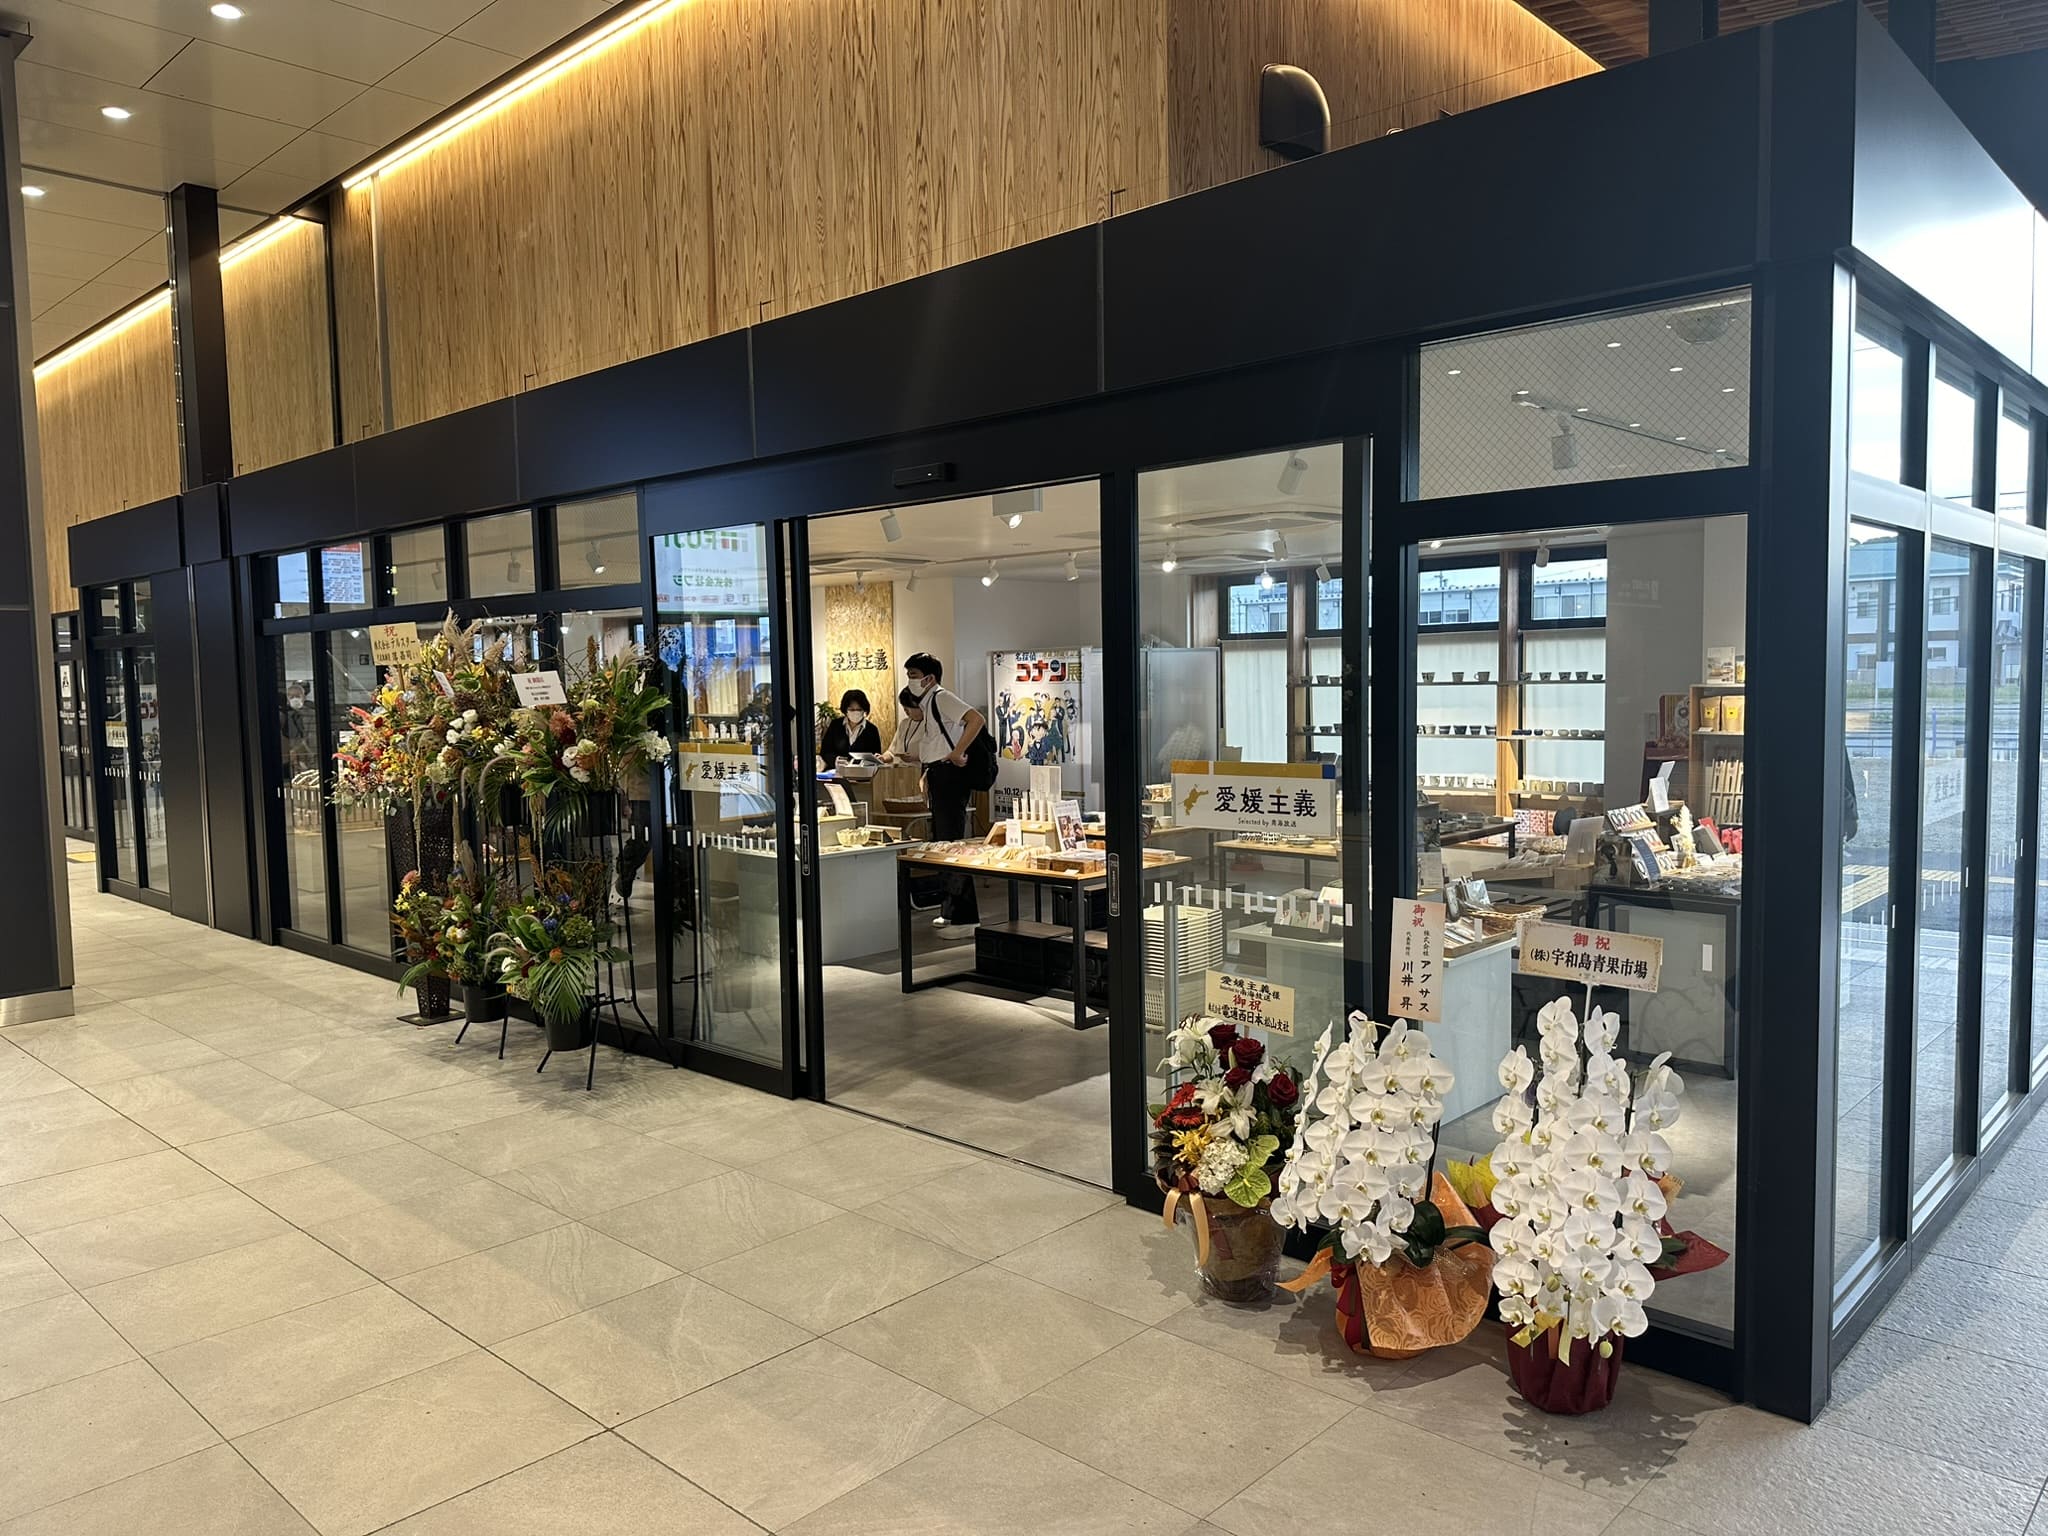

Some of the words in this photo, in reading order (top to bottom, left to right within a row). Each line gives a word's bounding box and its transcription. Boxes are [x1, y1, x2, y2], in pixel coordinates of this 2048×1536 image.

[1015, 660, 1082, 682] コナン展
[701, 760, 751, 782] 愛媛主義
[1214, 785, 1317, 817] 愛媛主義
[1412, 904, 1426, 928] 御祝
[1573, 932, 1611, 951] 御祝
[1232, 994, 1263, 1013] 御祝
